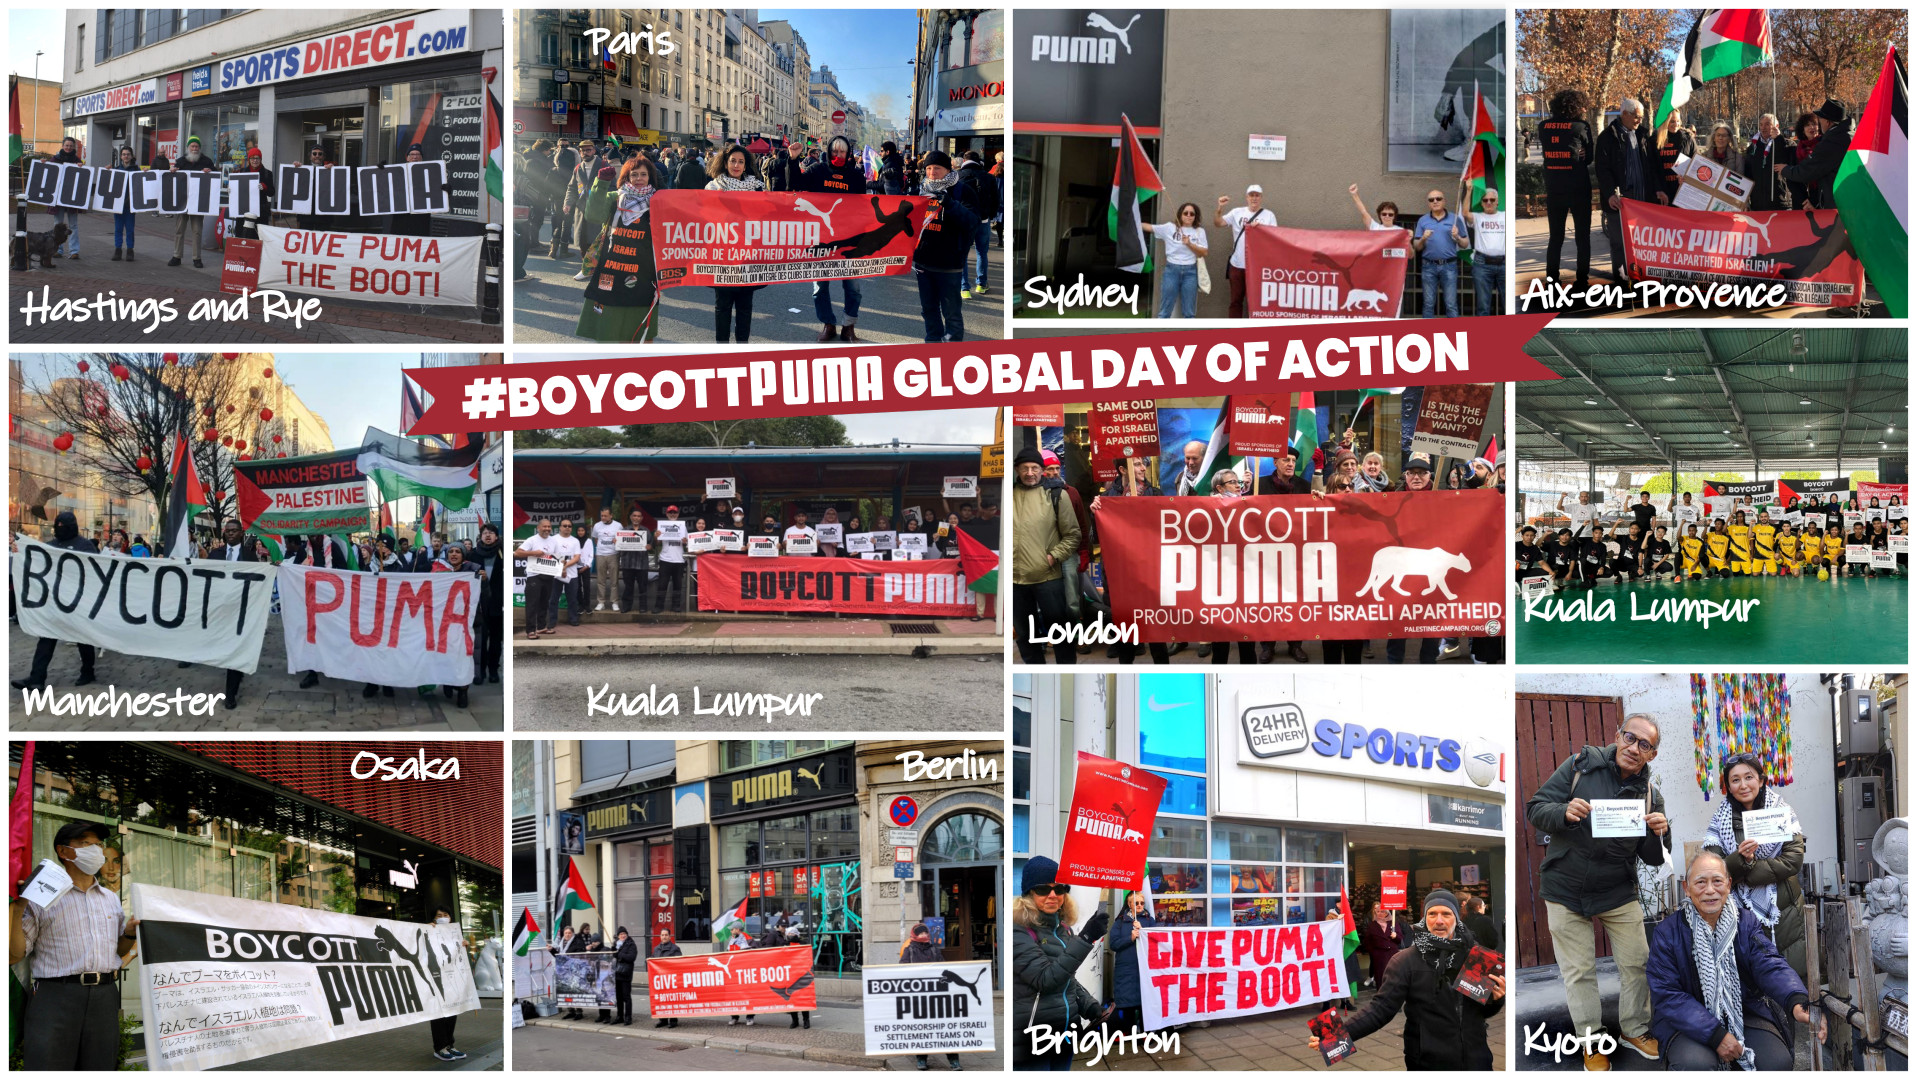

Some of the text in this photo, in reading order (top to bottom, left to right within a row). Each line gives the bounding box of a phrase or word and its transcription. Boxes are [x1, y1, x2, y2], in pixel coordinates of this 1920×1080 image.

[1031, 35, 1117, 64] PUMA
[221, 47, 300, 89] SPORTS
[76, 93, 106, 116] SPORTS
[1545, 151, 1571, 159] PALESTINE
[29, 162, 259, 216] BOYCOTT
[280, 162, 445, 214] PUMA
[824, 180, 849, 190] BOYCOTT
[614, 226, 645, 239] BOYCOTT
[662, 220, 820, 246] TACLONS PUMA
[1627, 224, 1759, 257] TACLONS PUMA
[284, 230, 441, 264] GIVE PUMA
[613, 244, 637, 256] ISRAEL
[661, 247, 784, 261] SPONSOR DE L'APARTHEID
[1660, 251, 1671, 263] DE
[225, 263, 245, 273] PUMA
[604, 259, 639, 273] APARTHEID
[696, 264, 730, 274] BOYCOTTONS
[282, 260, 440, 298] THE BOOT!
[724, 274, 748, 283] FOOTBALL
[1262, 267, 1339, 285] BOYCOTT
[1261, 281, 1339, 311] PUMA
[1096, 399, 1154, 412] SAME OLD
[1427, 400, 1481, 416] IS THIS THE
[1112, 412, 1155, 423] SUPPORT
[1235, 412, 1267, 424] PUMA
[1421, 409, 1483, 426] LEGACY YOU
[1101, 424, 1156, 435] FOR ISRAELI
[1431, 420, 1468, 433] WANT?
[1105, 434, 1157, 446] APARTHEID
[1427, 436, 1439, 444] THE
[1440, 438, 1477, 450] CONTRACT!
[1728, 484, 1767, 493] BOYCOTT
[276, 486, 366, 508] PALESTINE
[533, 500, 576, 510] BOYCOTT
[260, 515, 368, 529] SOLIDARITY CAMPAIGN
[1160, 507, 1337, 544] BOYCOTT
[536, 558, 557, 567] PUMA
[1159, 541, 1338, 606] PUMA
[740, 571, 976, 605] BOYCOTT PUMA
[1529, 582, 1547, 590] PUMA
[21, 544, 474, 657] BOYCOTT PUMA
[1132, 602, 1502, 626] PROUD SPONSORS OF ISRAELI APARTHEID
[1404, 625, 1485, 633] PALESTINECAMPAIGN.ORG
[1250, 711, 1300, 733] 24HR
[1253, 729, 1305, 747] DELIVERY
[1311, 719, 1462, 773] SPORTS
[732, 769, 793, 806] PUMA
[1077, 807, 1125, 825] BOYCOTT
[1457, 803, 1486, 815] karrimor
[587, 804, 628, 832] PUMA
[1074, 815, 1123, 841] PUMA
[1069, 863, 1096, 872] PROUD
[1072, 871, 1100, 880] ISRAELI
[658, 912, 672, 923] BIS
[205, 928, 358, 962] BOYCOTT
[1147, 923, 1325, 970] GIVE PUMA
[653, 965, 792, 990] GIVE PUMA THE BOOT
[871, 978, 939, 994] BOYCOTT
[1151, 957, 1340, 1019] THE BOOT!
[317, 963, 424, 1026] PUMA
[896, 993, 969, 1020] PUMA
[874, 1021, 987, 1032] END SPONSORSHIP OF ISRAELI
[886, 1030, 975, 1041] SETTLEMENT TEAMS ON
[880, 1039, 983, 1051] STOLEN PALESTINIAN LAND
